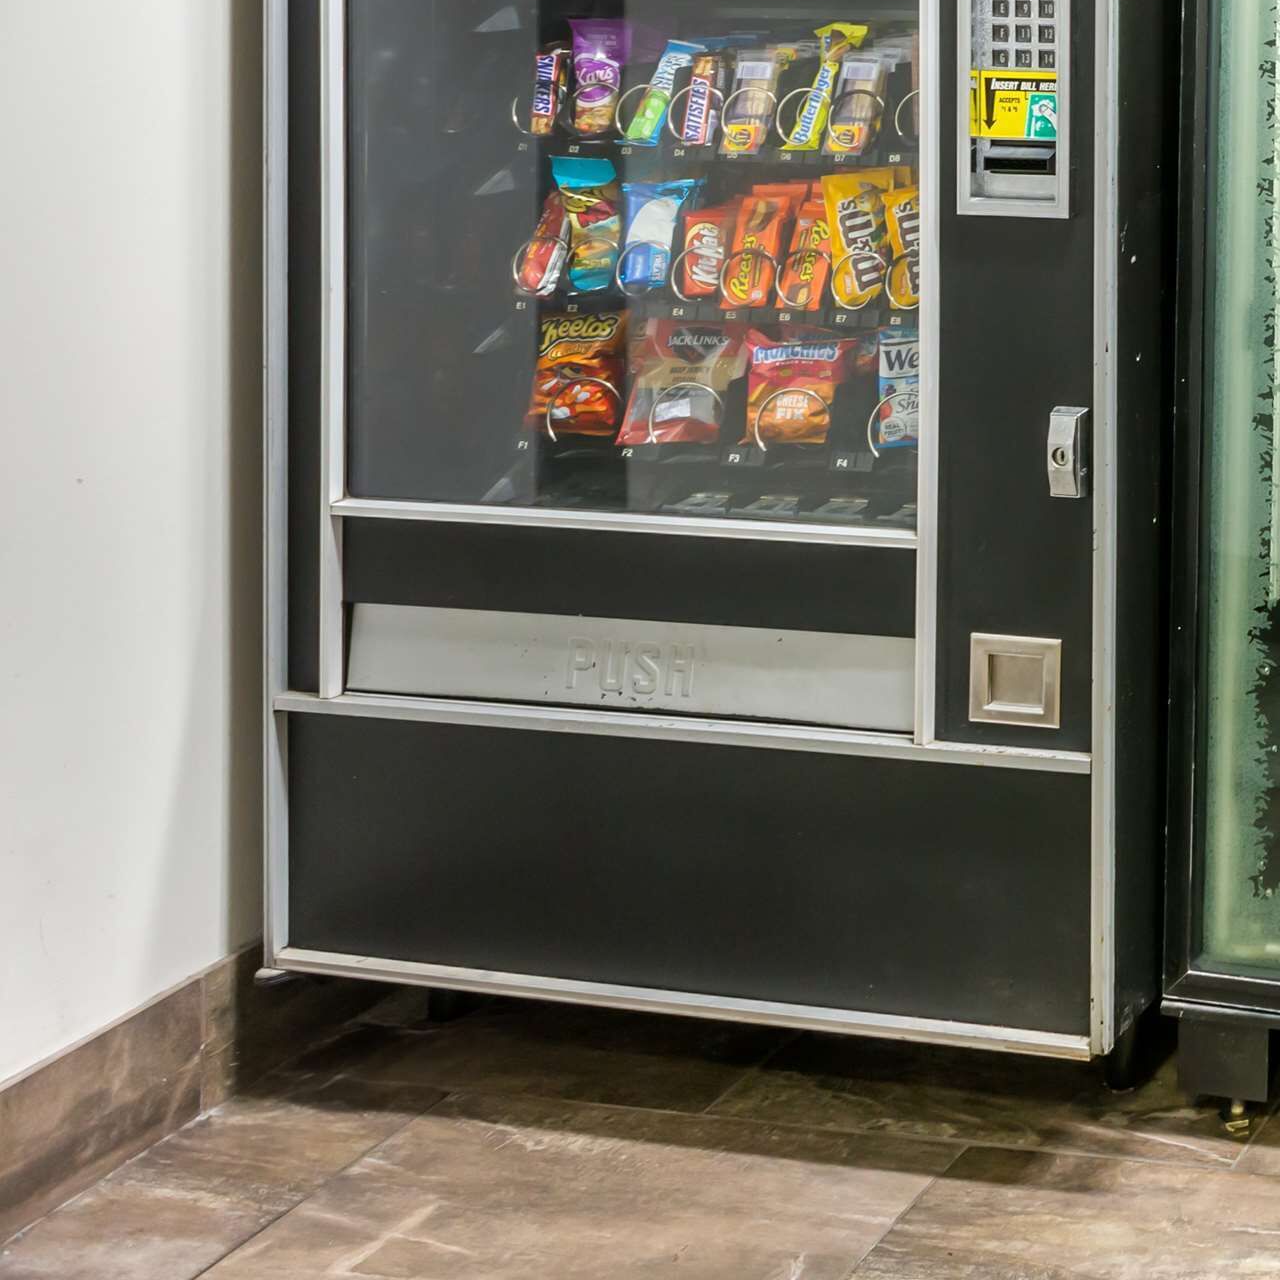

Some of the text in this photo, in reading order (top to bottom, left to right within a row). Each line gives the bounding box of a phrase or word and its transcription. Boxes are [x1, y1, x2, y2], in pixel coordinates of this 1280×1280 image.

[534, 56, 556, 114] SNICKERS
[991, 78, 1037, 90] INSERT BILL
[793, 66, 832, 143] Butterfinger
[834, 154, 846, 162] D7
[889, 154, 900, 162] D8
[730, 234, 757, 299] Reese's
[516, 302, 526, 310] E1
[672, 308, 684, 316] E4
[667, 336, 692, 347] JACK
[754, 344, 838, 364] MUNCHIES
[884, 348, 919, 371] We
[776, 395, 808, 406] CHEESE
[776, 408, 804, 420] FIX
[518, 441, 528, 449] F1
[728, 454, 740, 462] F3
[836, 459, 848, 468] F4
[566, 636, 696, 698] PUSH
